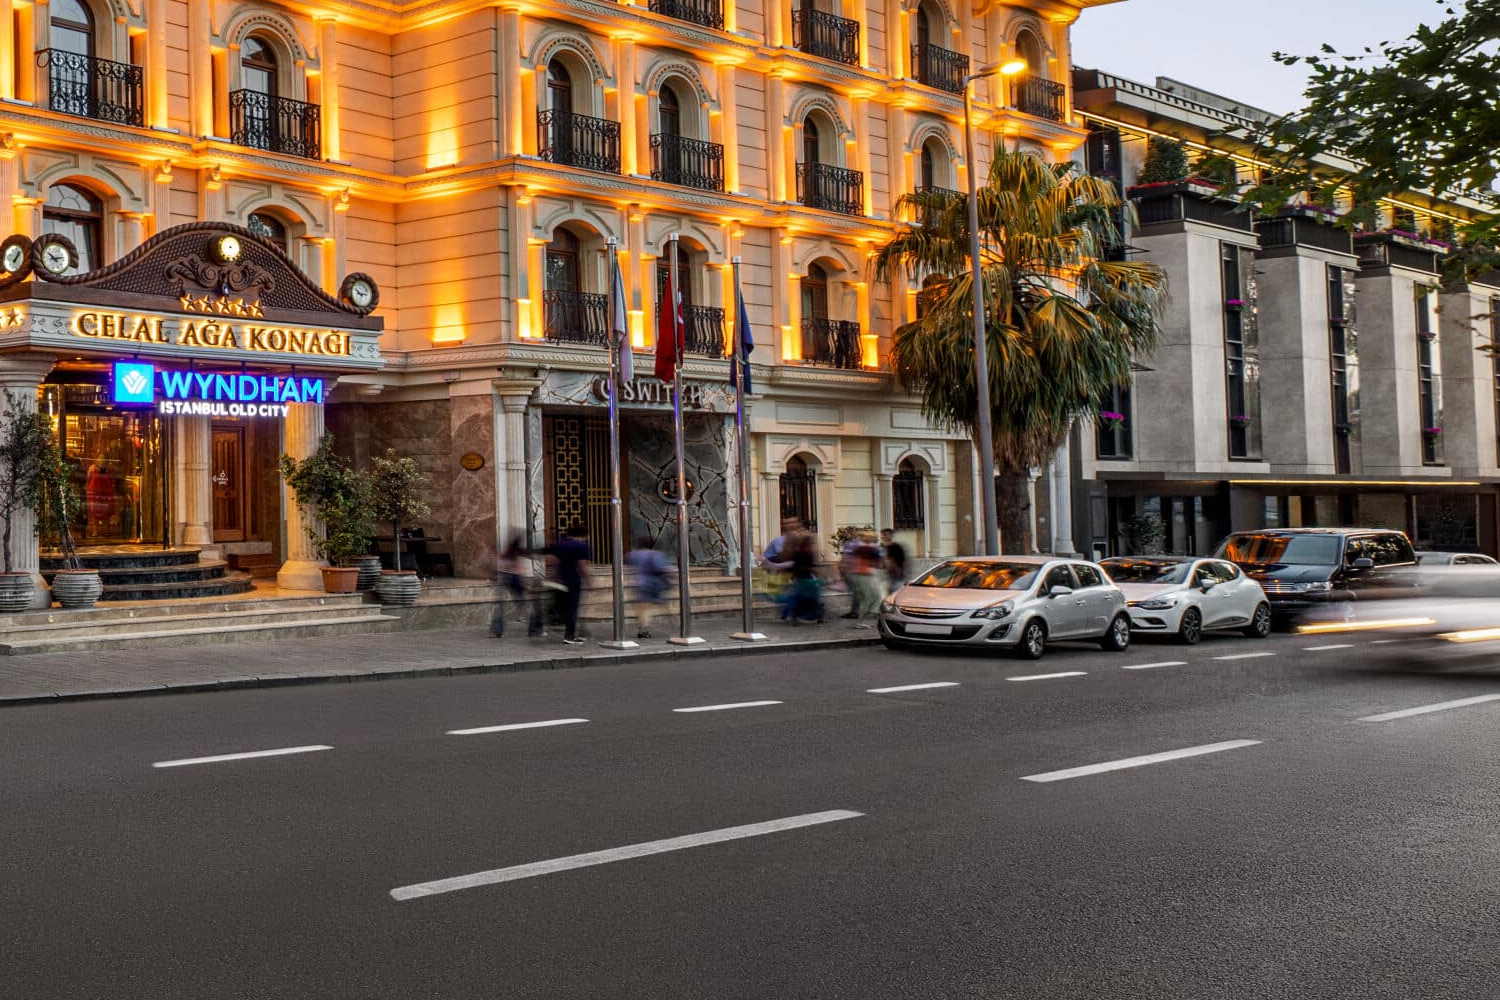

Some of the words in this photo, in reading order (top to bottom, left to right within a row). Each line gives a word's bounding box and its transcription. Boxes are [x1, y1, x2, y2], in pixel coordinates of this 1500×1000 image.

[77, 312, 170, 343] CELAL
[180, 319, 239, 348] AĞA
[247, 327, 352, 356] KONAĞI
[161, 371, 323, 404] WYNDHAM
[160, 401, 229, 416] ISTANBUL
[228, 403, 258, 416] OLD
[258, 404, 290, 417] CITY
